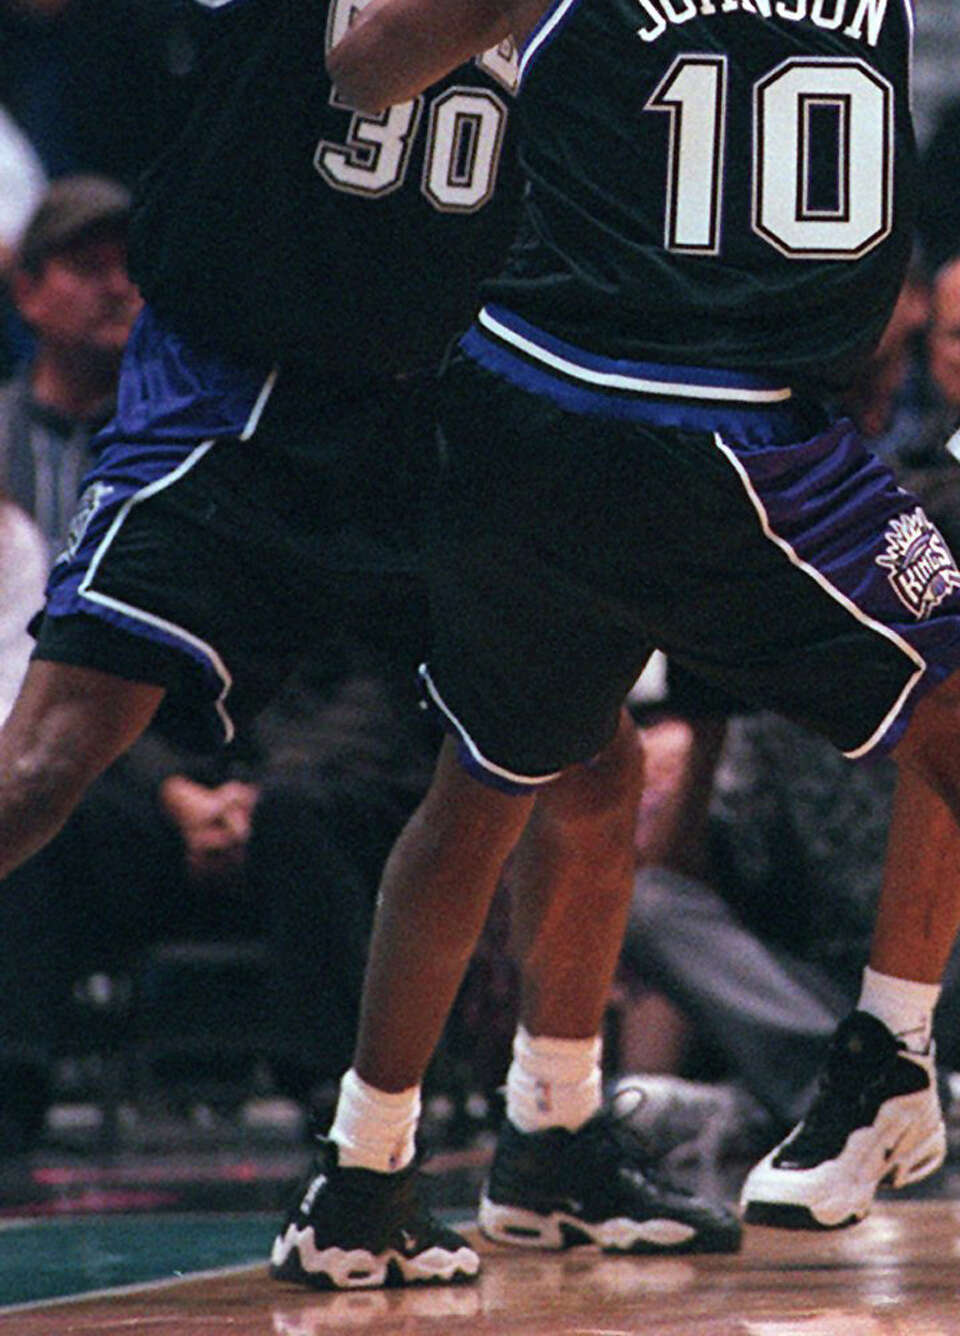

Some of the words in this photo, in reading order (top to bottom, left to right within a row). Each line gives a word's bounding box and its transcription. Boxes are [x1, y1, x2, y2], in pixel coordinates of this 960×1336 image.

[314, 85, 508, 214] 30
[643, 53, 894, 260] 10
[898, 532, 953, 604] KINGS
